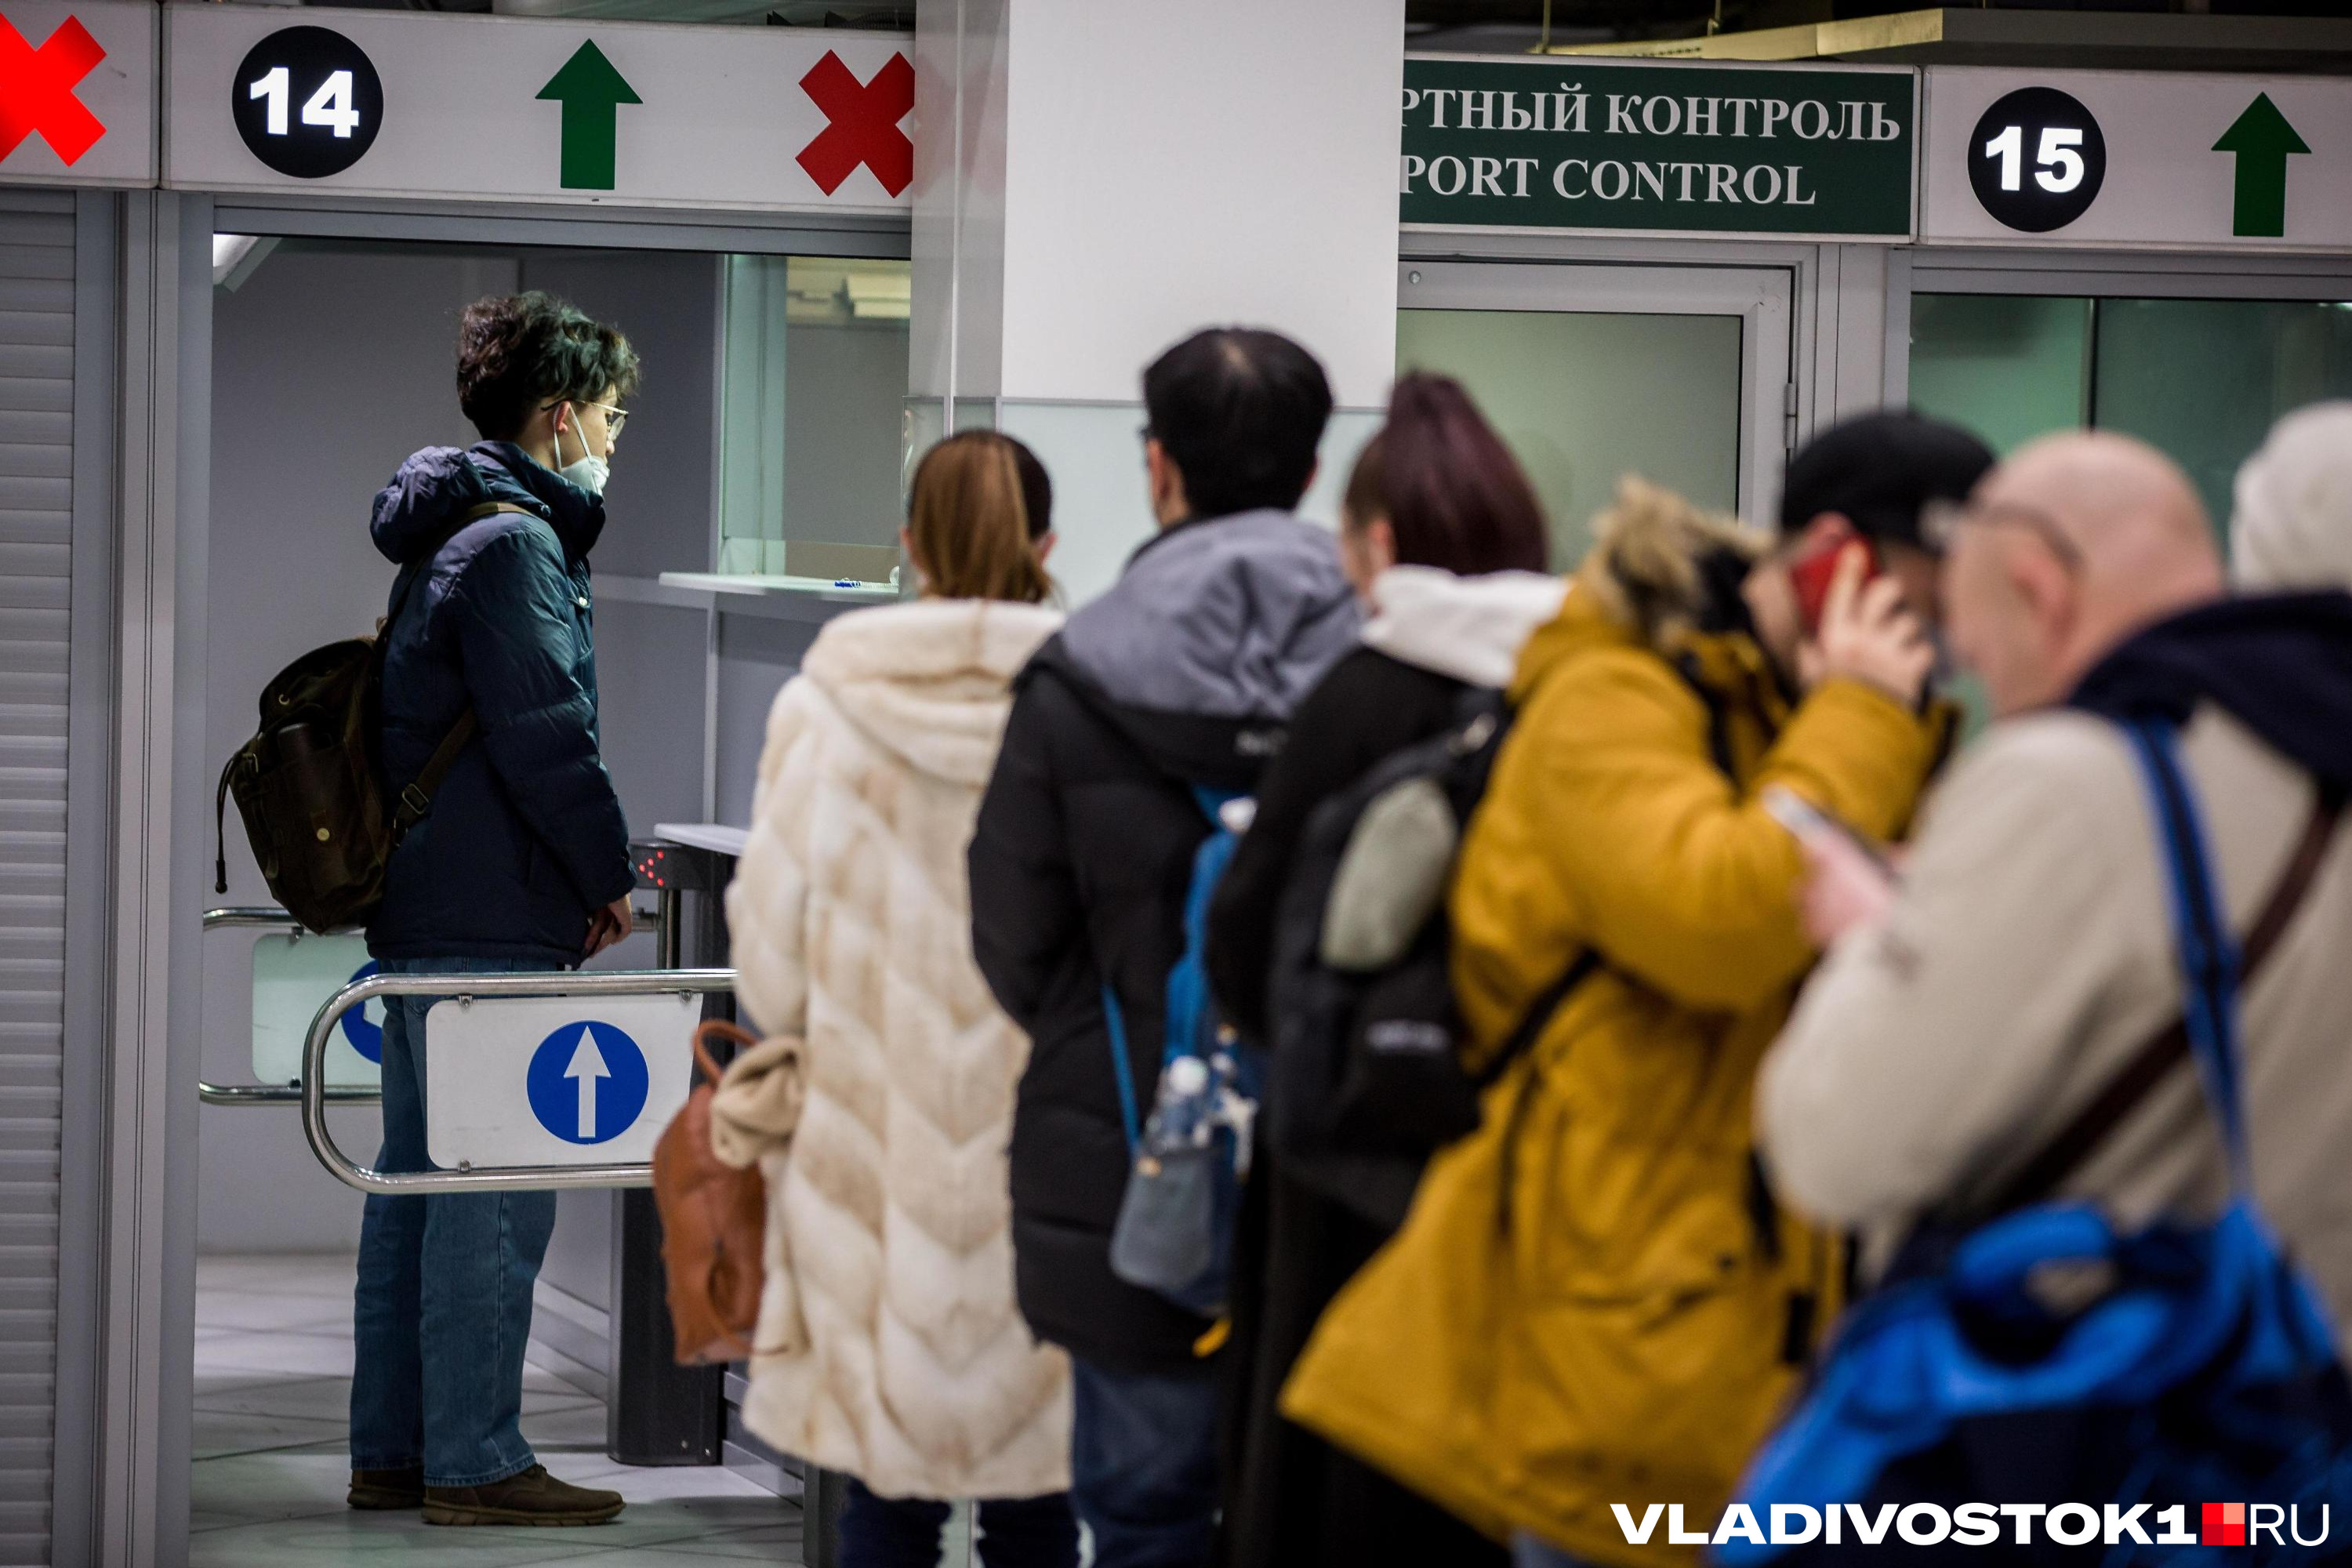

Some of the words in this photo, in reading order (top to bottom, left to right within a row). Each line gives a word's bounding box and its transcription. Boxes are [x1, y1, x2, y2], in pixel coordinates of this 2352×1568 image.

[249, 67, 361, 139] 14
[1604, 95, 1900, 140] КОНТРОЛЬ
[1399, 154, 1539, 198] PORT
[1552, 159, 1817, 205] CONTROL
[1985, 125, 2085, 194] 15
